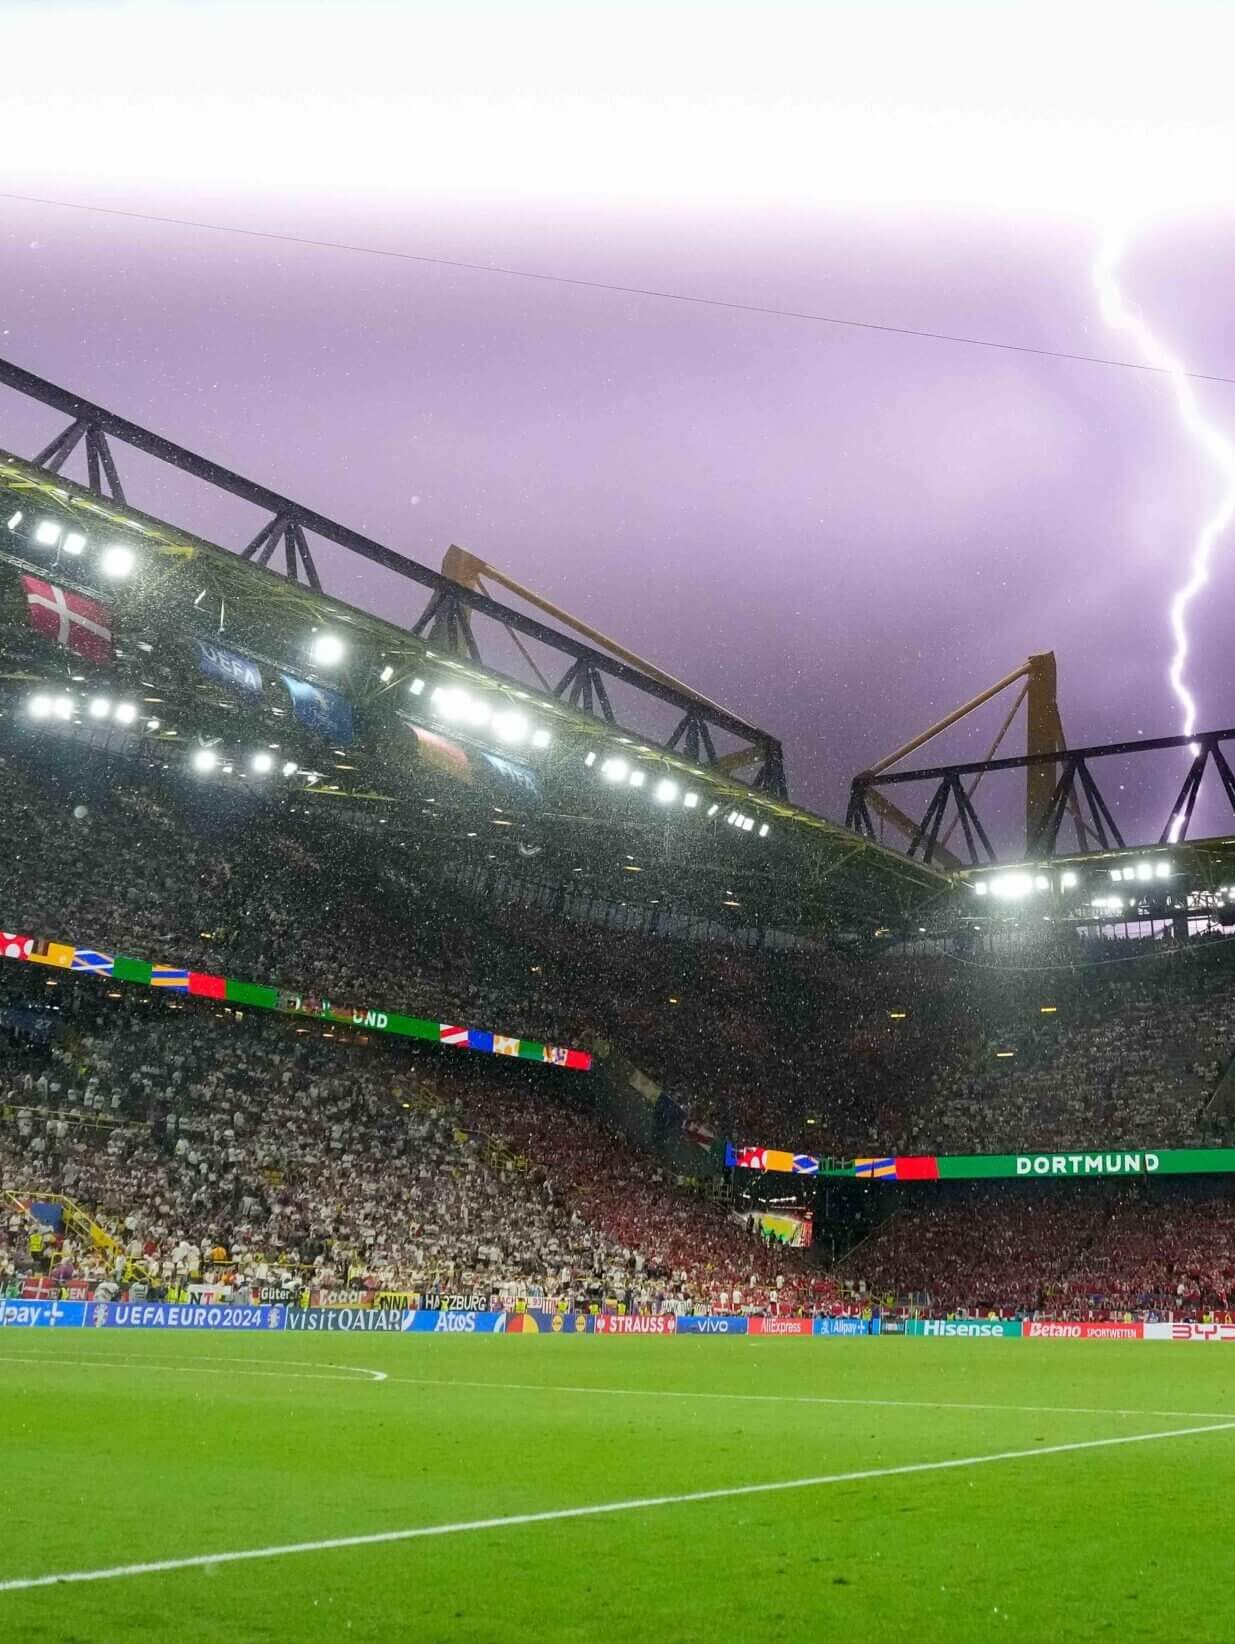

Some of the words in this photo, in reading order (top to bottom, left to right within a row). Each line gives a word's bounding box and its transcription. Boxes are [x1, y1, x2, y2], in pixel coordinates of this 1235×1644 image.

[1016, 1153, 1160, 1174] DORTMUND
[609, 1316, 664, 1333] STRAUSS
[697, 1318, 728, 1333] vivo
[760, 1318, 801, 1333] AliExpress
[924, 1320, 1004, 1337] Hisense
[1030, 1322, 1081, 1338] Betano
